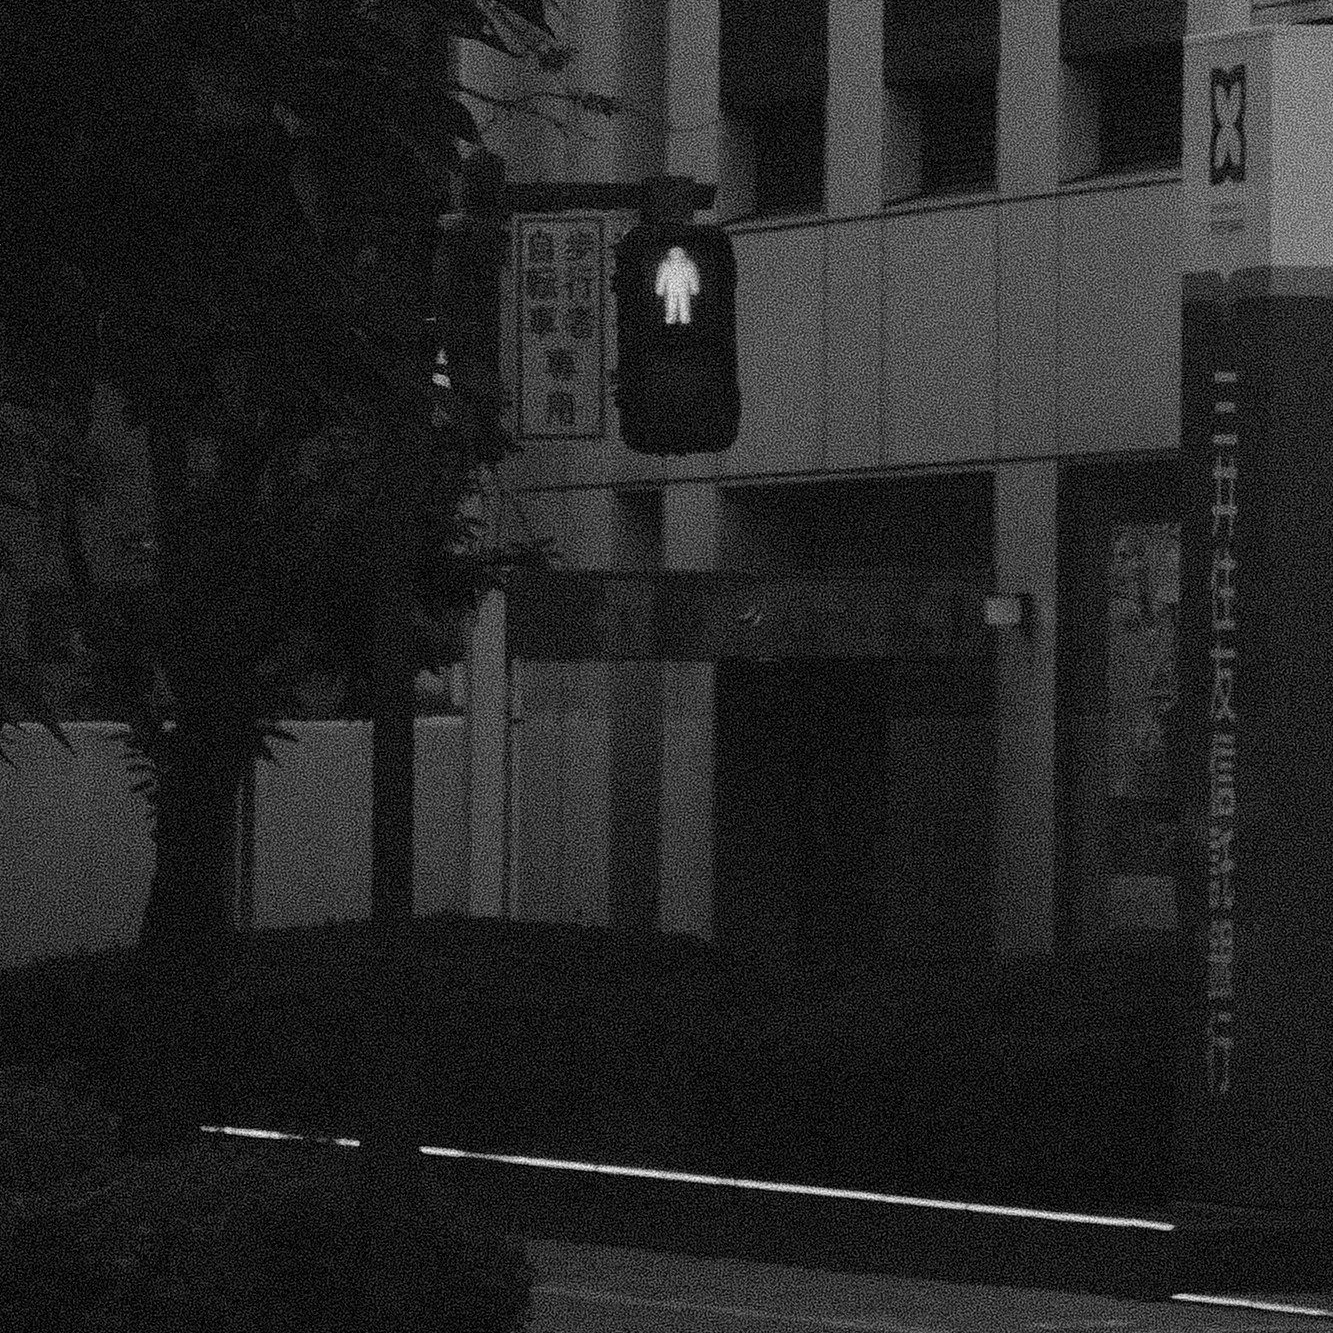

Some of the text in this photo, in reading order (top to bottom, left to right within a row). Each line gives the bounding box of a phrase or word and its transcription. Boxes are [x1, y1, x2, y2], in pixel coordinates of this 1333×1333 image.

[526, 228, 558, 341] 自転車
[564, 229, 595, 340] 歩行者
[544, 348, 578, 426] 専用
[1205, 369, 1239, 1097] 三井住友信託銀行
